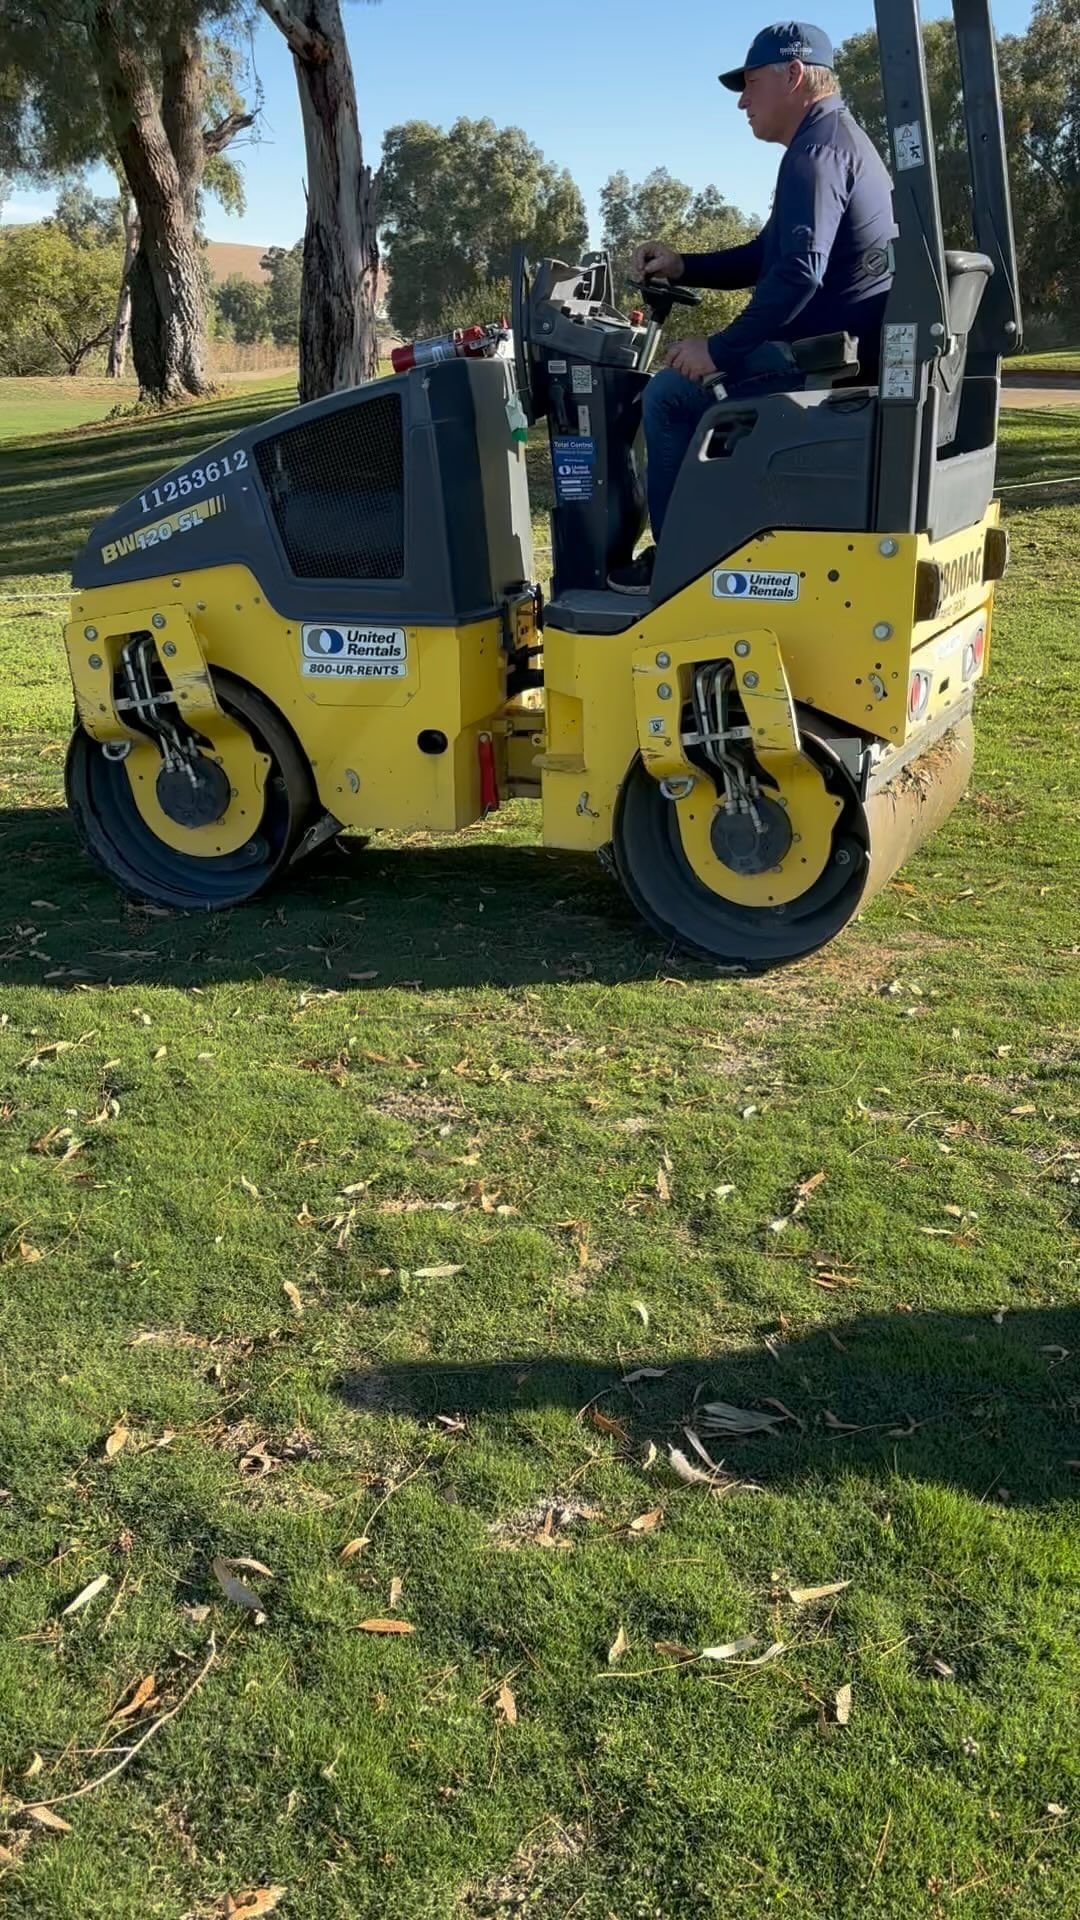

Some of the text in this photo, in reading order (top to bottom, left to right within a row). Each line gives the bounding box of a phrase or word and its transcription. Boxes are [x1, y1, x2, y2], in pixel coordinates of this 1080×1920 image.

[139, 449, 249, 513] 11253612
[749, 574, 791, 586] United
[943, 547, 982, 600] BOMAG
[749, 586, 794, 597] Rentals
[347, 630, 395, 644] United
[347, 643, 401, 656] Rentals
[309, 664, 399, 675] 800-UR-RENTS
